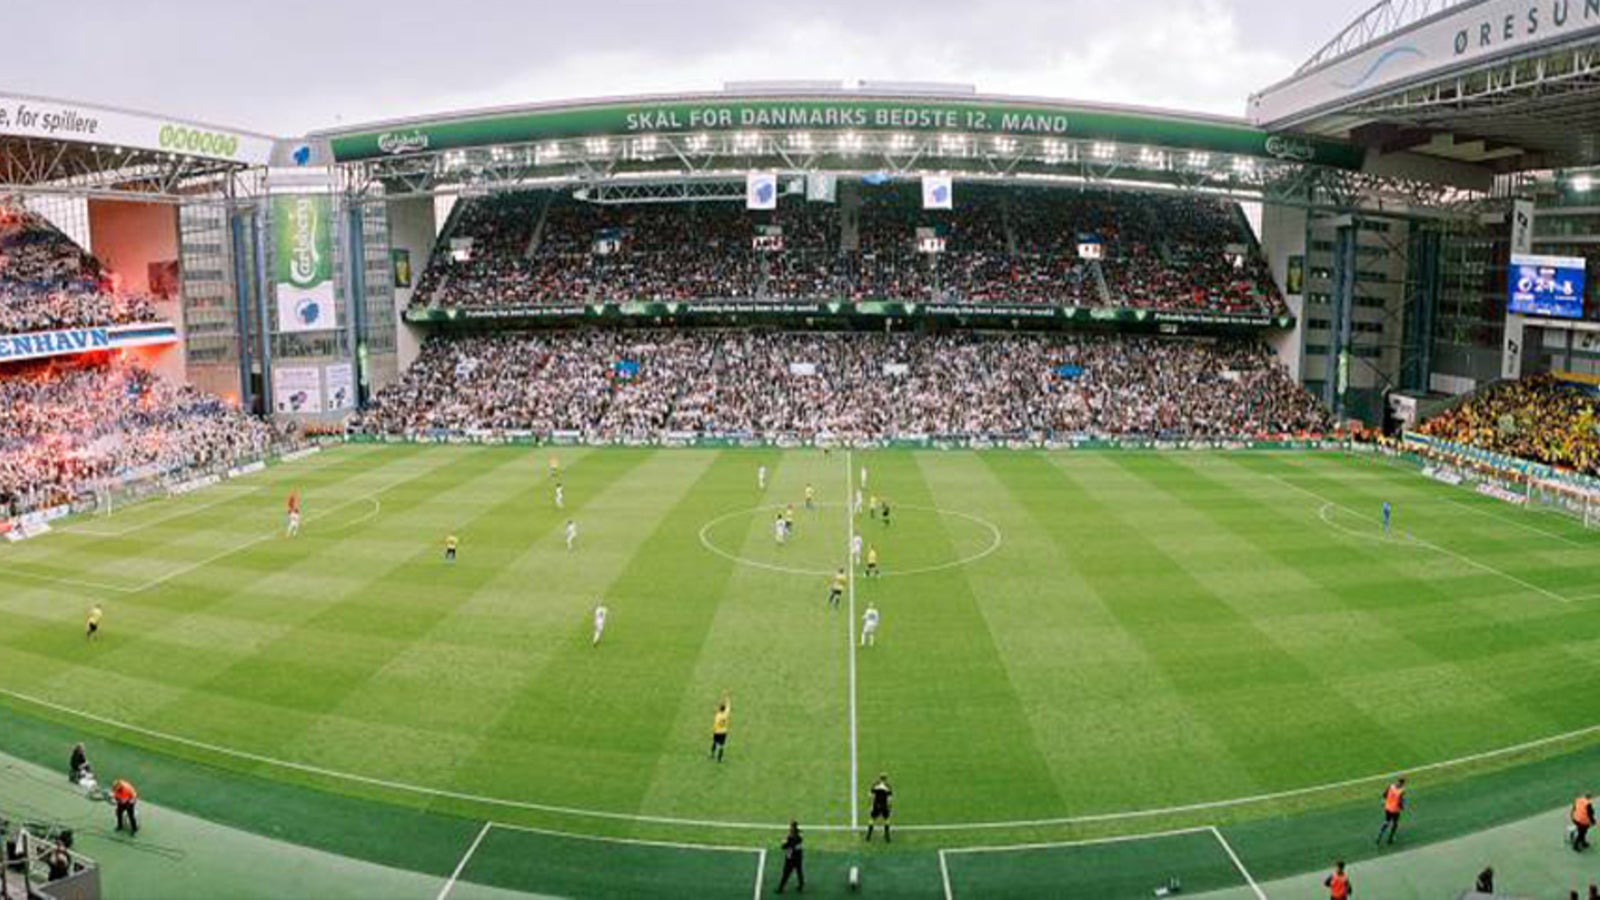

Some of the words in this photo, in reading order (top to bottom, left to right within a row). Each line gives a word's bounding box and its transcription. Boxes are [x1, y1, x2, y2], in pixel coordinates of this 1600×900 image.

[16, 104, 38, 127] for
[41, 110, 98, 134] spillere
[690, 108, 732, 128] FOR
[741, 107, 867, 126] DANMARKS
[875, 109, 957, 128] BEDSTE
[965, 111, 993, 130] 12.
[1002, 113, 1068, 133] MAND
[377, 131, 428, 153] Carlsberg
